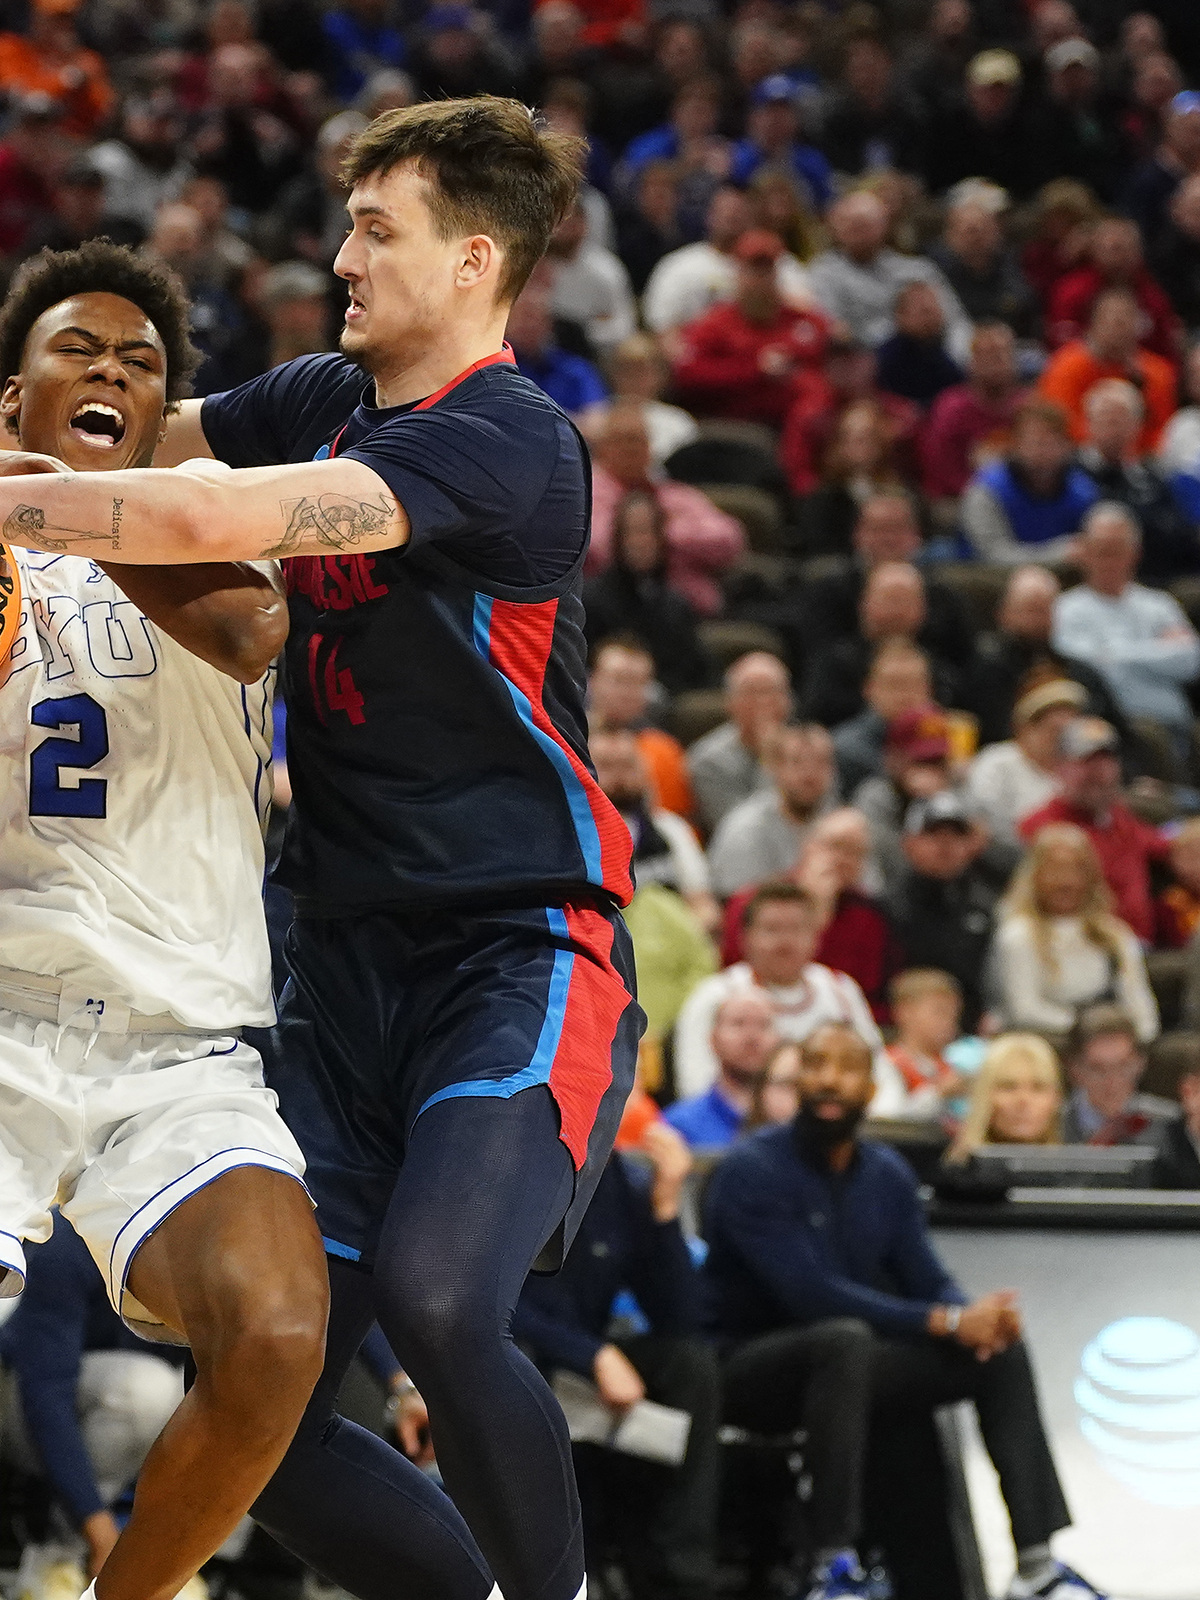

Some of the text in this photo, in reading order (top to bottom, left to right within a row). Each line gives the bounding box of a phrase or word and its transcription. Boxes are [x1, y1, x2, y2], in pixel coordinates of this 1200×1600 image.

[112, 497, 124, 550] Dedicated
[308, 633, 366, 726] 14
[29, 692, 109, 819] 2
